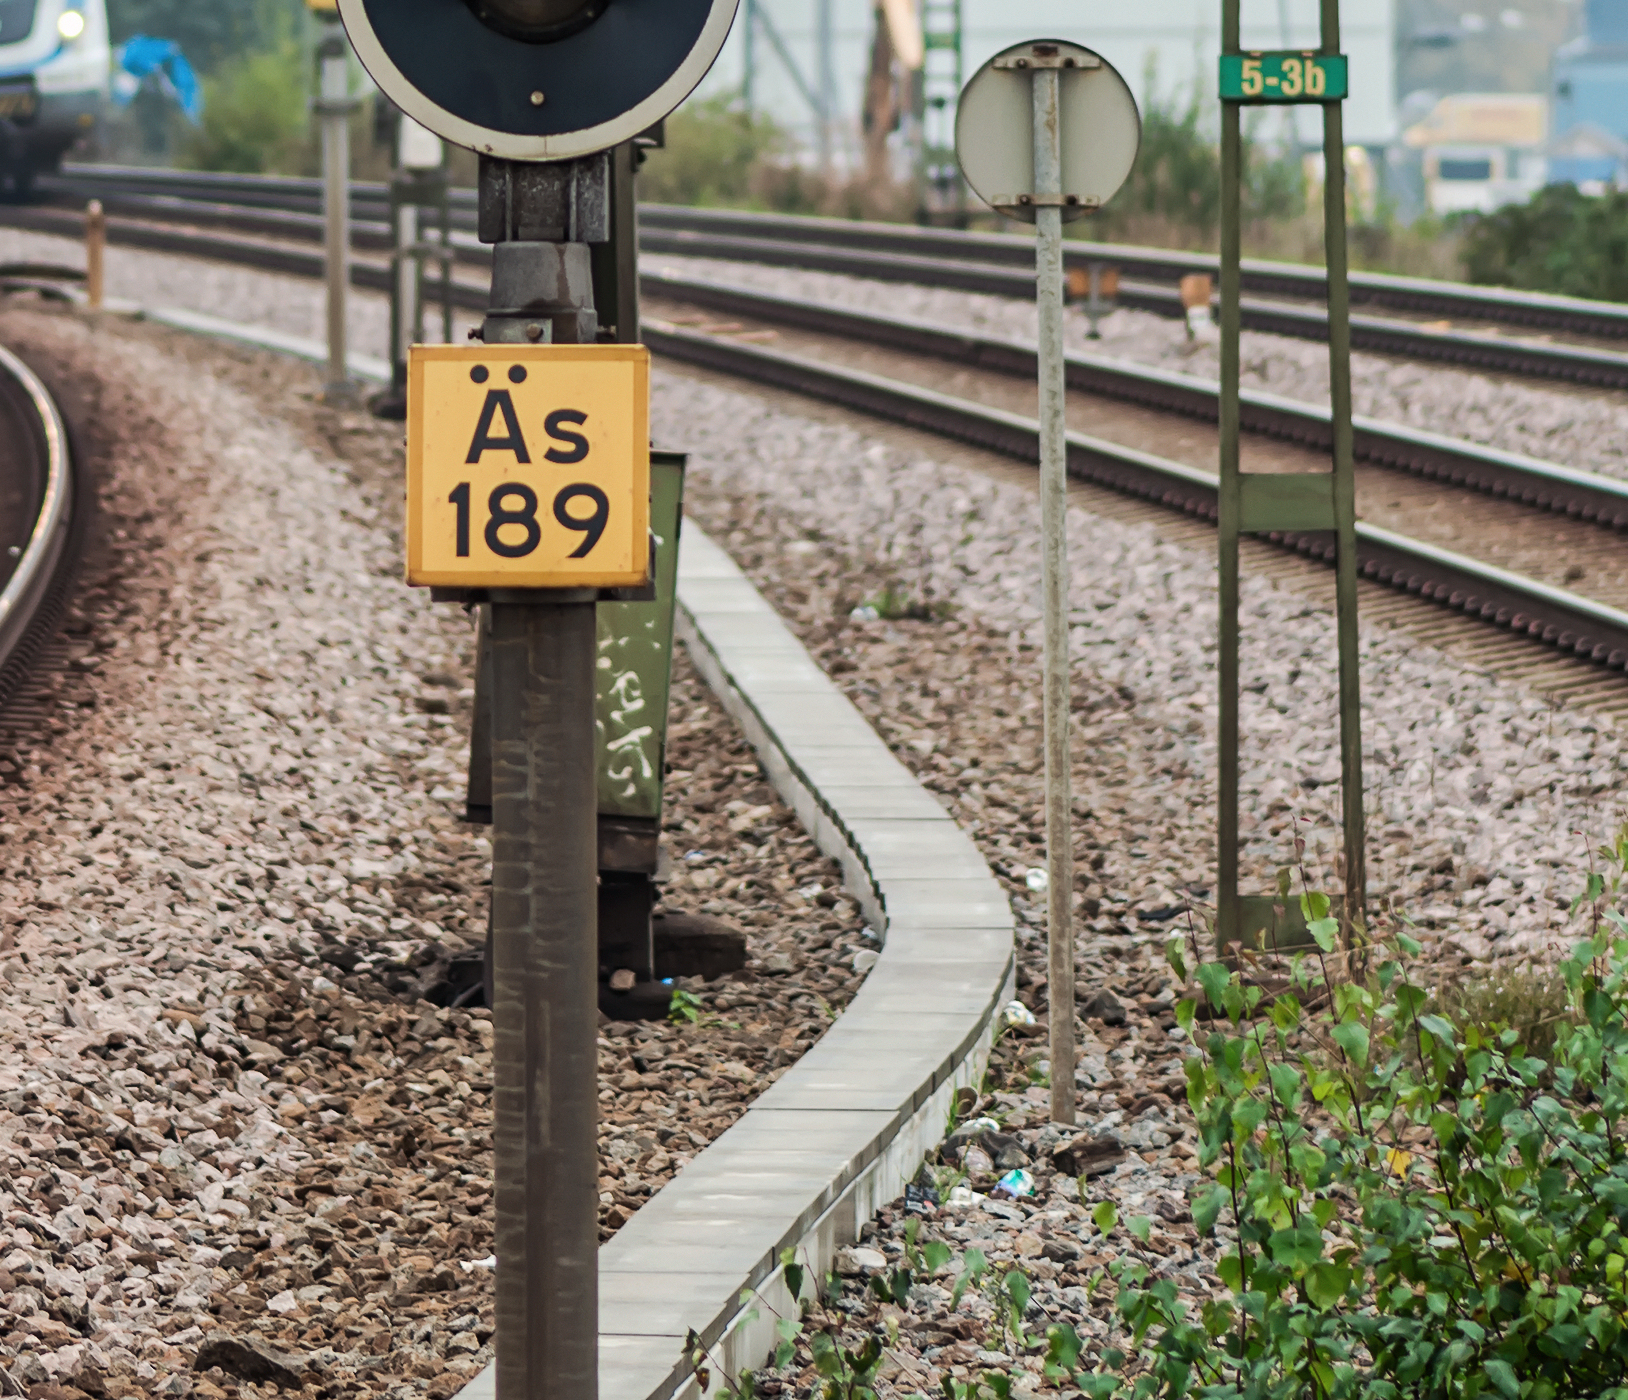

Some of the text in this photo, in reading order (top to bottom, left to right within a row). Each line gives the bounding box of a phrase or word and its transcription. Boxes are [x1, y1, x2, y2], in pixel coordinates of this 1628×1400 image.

[1241, 58, 1326, 96] 5-3b
[465, 364, 590, 464] Äs
[448, 482, 610, 558] 189
